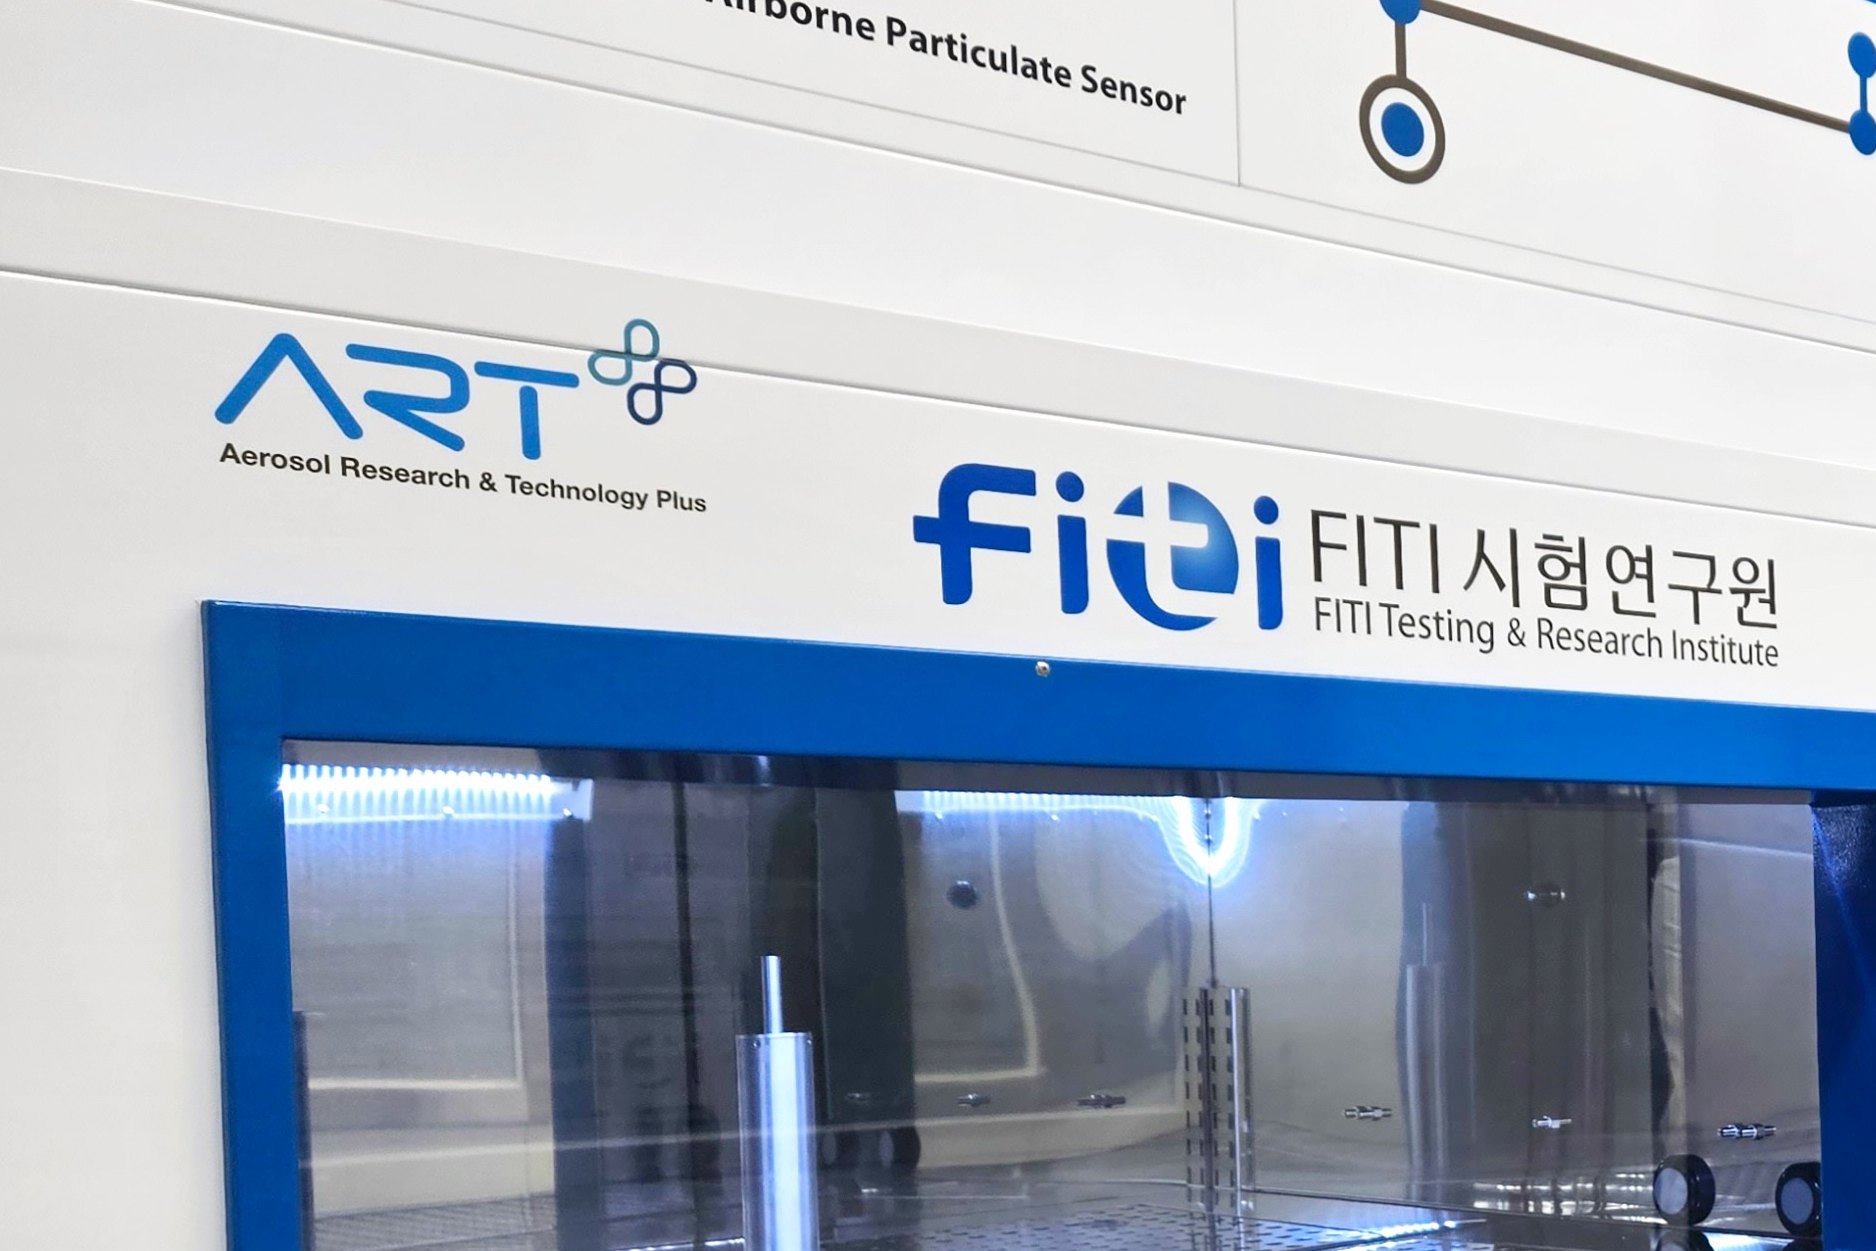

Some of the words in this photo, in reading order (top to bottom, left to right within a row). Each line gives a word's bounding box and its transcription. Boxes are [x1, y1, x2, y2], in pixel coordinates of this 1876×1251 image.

[705, 0, 876, 42] borne
[886, 15, 1072, 88] Particulate
[1081, 64, 1187, 115] Sensor
[214, 332, 580, 461] ART
[219, 442, 331, 475] Aerosol
[340, 456, 471, 490] Research
[479, 471, 498, 493] &
[504, 473, 649, 511] Technology
[656, 489, 707, 513] Plus
[1310, 509, 1440, 594] FITI
[1463, 528, 1779, 629] 시험연구원
[1315, 596, 1372, 635] FITI
[1378, 602, 1495, 654] Testing
[1507, 617, 1526, 648] &
[1537, 617, 1663, 659] Research
[1672, 629, 1779, 667] Institute
